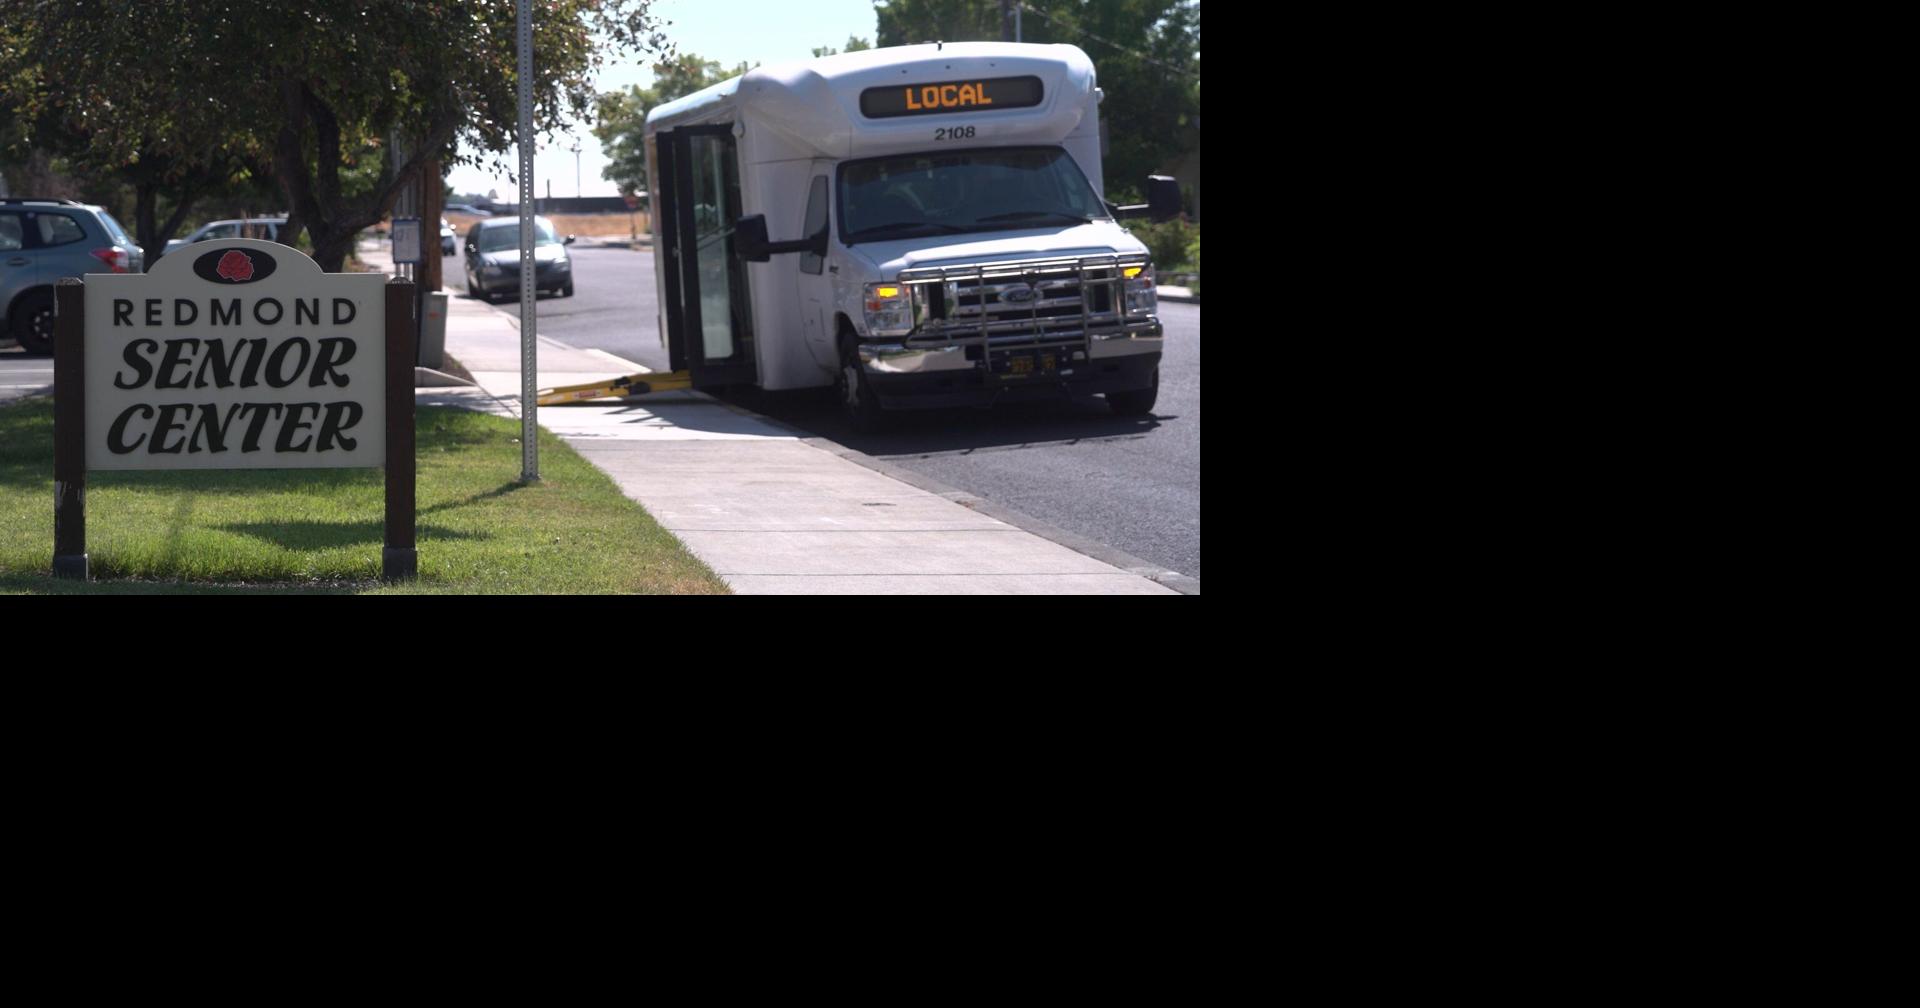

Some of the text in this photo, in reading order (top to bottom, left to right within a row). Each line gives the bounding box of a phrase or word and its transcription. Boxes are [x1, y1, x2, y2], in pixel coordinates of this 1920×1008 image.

[906, 83, 992, 110] LOCAL
[934, 126, 976, 141] 2108
[113, 297, 357, 326] REDMOND
[113, 336, 357, 390] SENIOR
[107, 401, 363, 454] CENTER
